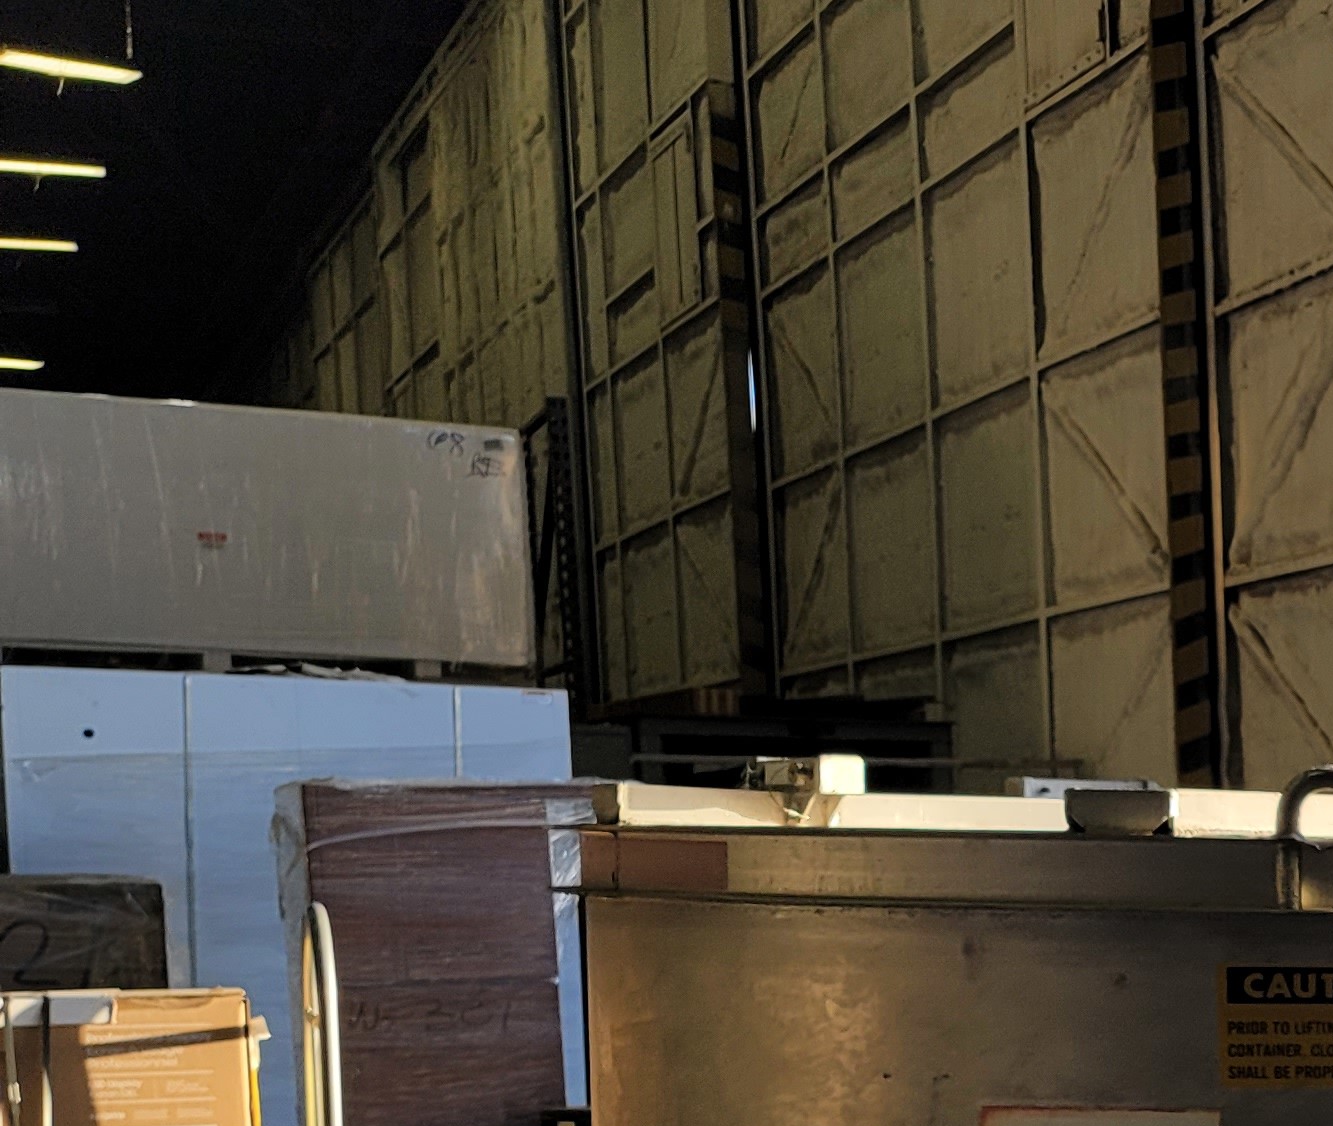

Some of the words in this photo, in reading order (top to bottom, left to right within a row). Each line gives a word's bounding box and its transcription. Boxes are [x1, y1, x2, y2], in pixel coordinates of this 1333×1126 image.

[1227, 1020, 1268, 1035] PRIOR
[1273, 1020, 1289, 1035] TO
[1228, 1065, 1267, 1080] SHALL
[1274, 1065, 1290, 1080] BE
